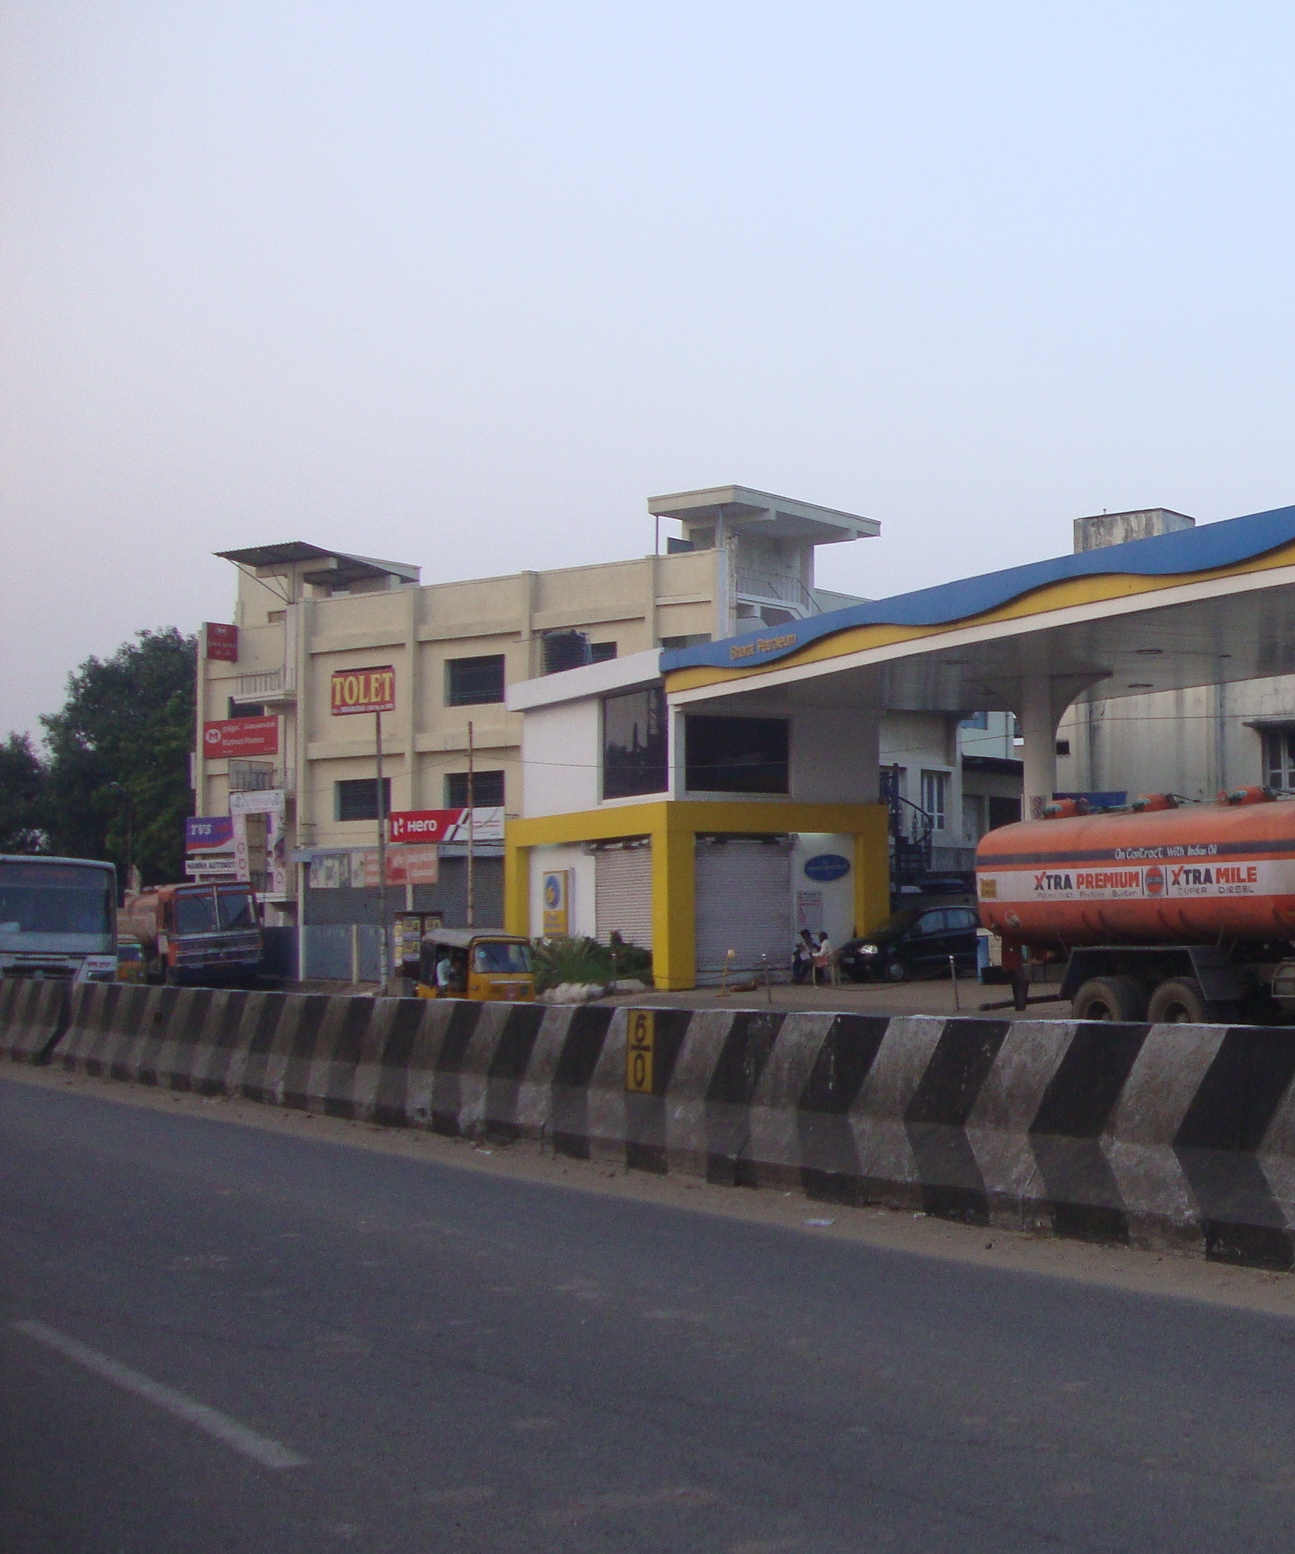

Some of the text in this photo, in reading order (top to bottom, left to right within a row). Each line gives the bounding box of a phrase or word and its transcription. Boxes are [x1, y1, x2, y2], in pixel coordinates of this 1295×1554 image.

[730, 634, 797, 660] Bharat Petroleum
[191, 824, 212, 835] TVS
[407, 819, 438, 833] Hero
[1115, 843, 1218, 860] On Contract With Indian Oil
[1034, 871, 1073, 891] XTRA
[1076, 871, 1140, 890] PREMIUM
[1171, 865, 1213, 886] XTRA
[1215, 866, 1258, 884] MILE
[1218, 885, 1254, 894] DIESEL
[634, 1013, 646, 1043] 6
[634, 1053, 646, 1088] 0
